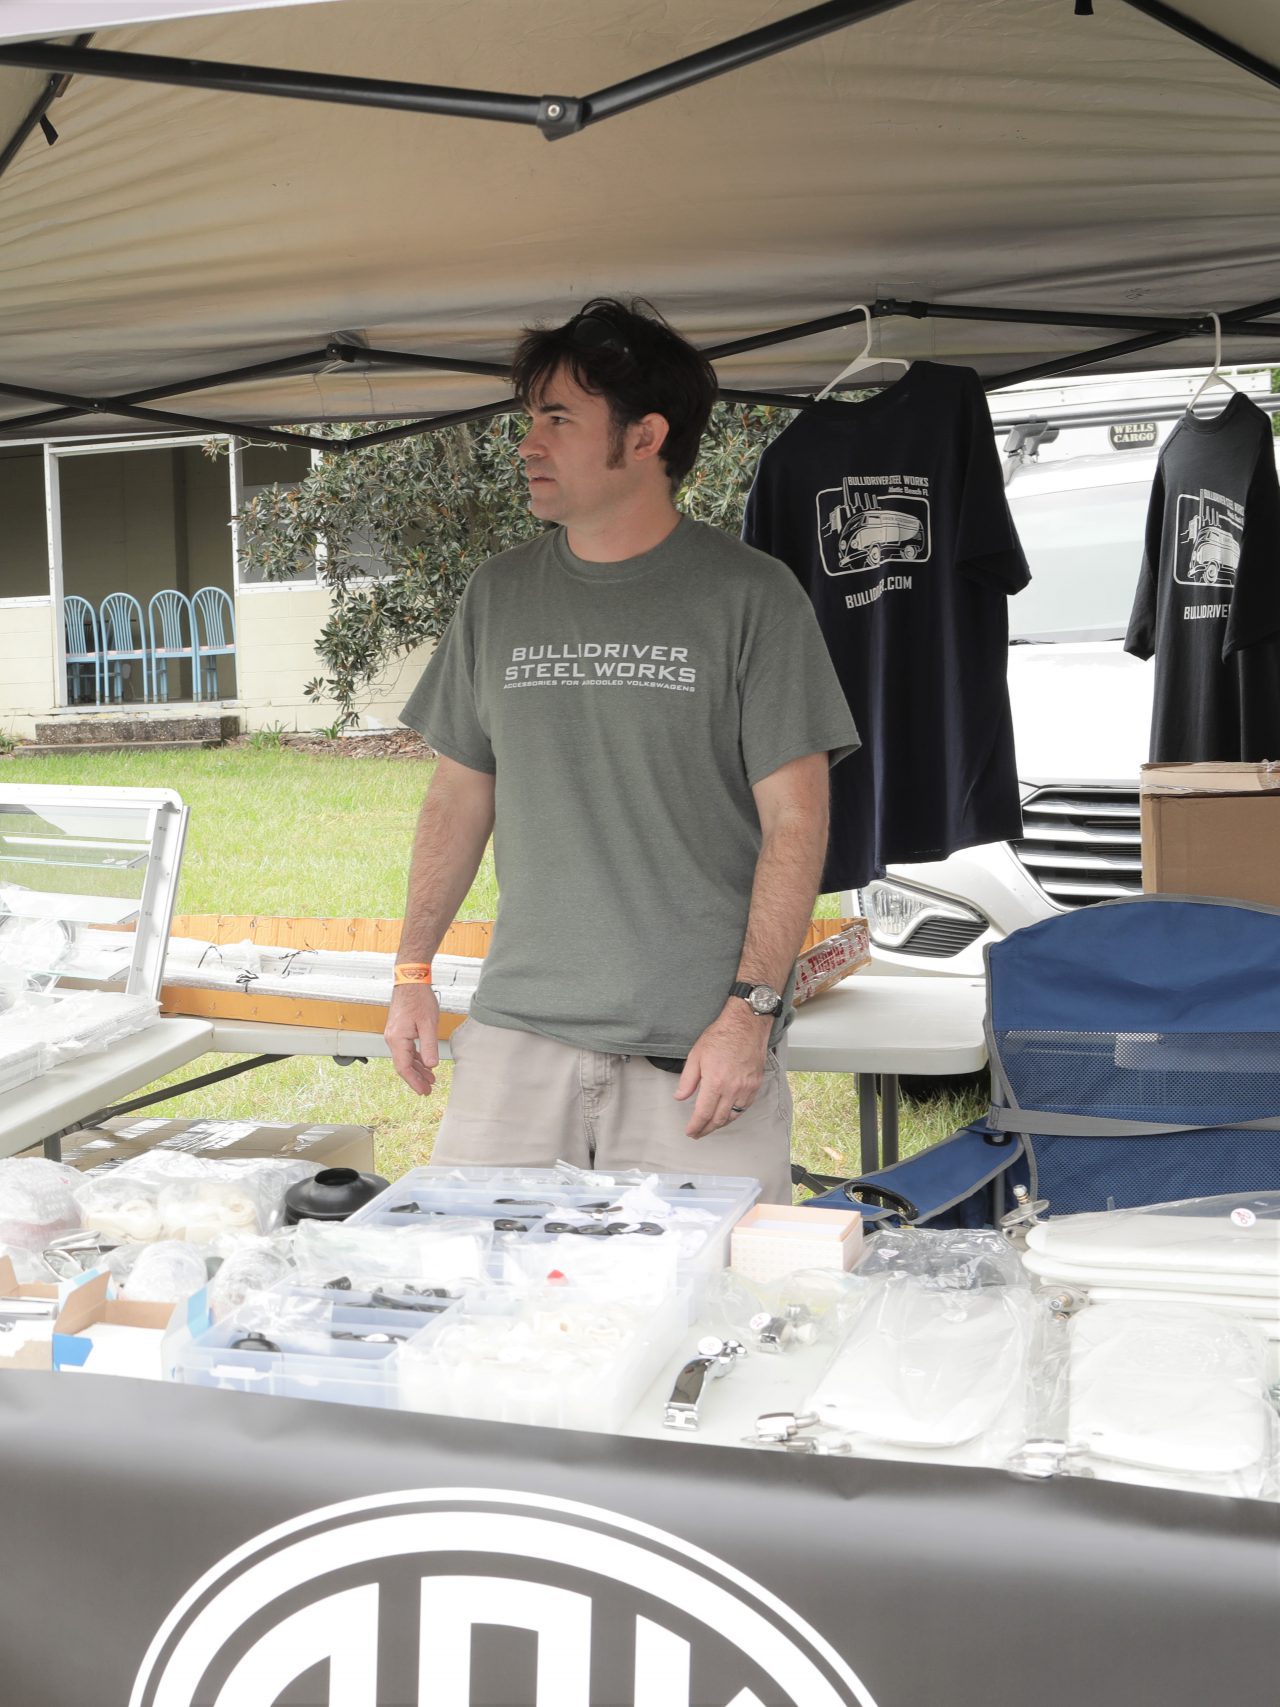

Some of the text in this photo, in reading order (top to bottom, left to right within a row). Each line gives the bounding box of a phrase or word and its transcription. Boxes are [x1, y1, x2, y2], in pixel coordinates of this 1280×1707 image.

[1114, 423, 1154, 434] WELLS
[1113, 432, 1155, 443] CARGO
[903, 475, 929, 487] WORKS
[1183, 604, 1231, 620] BULLIDRIVE
[504, 662, 696, 683] STEEL WORKS
[503, 680, 558, 689] ACCESSORIES
[626, 680, 696, 692] VOLKSWAGENS
